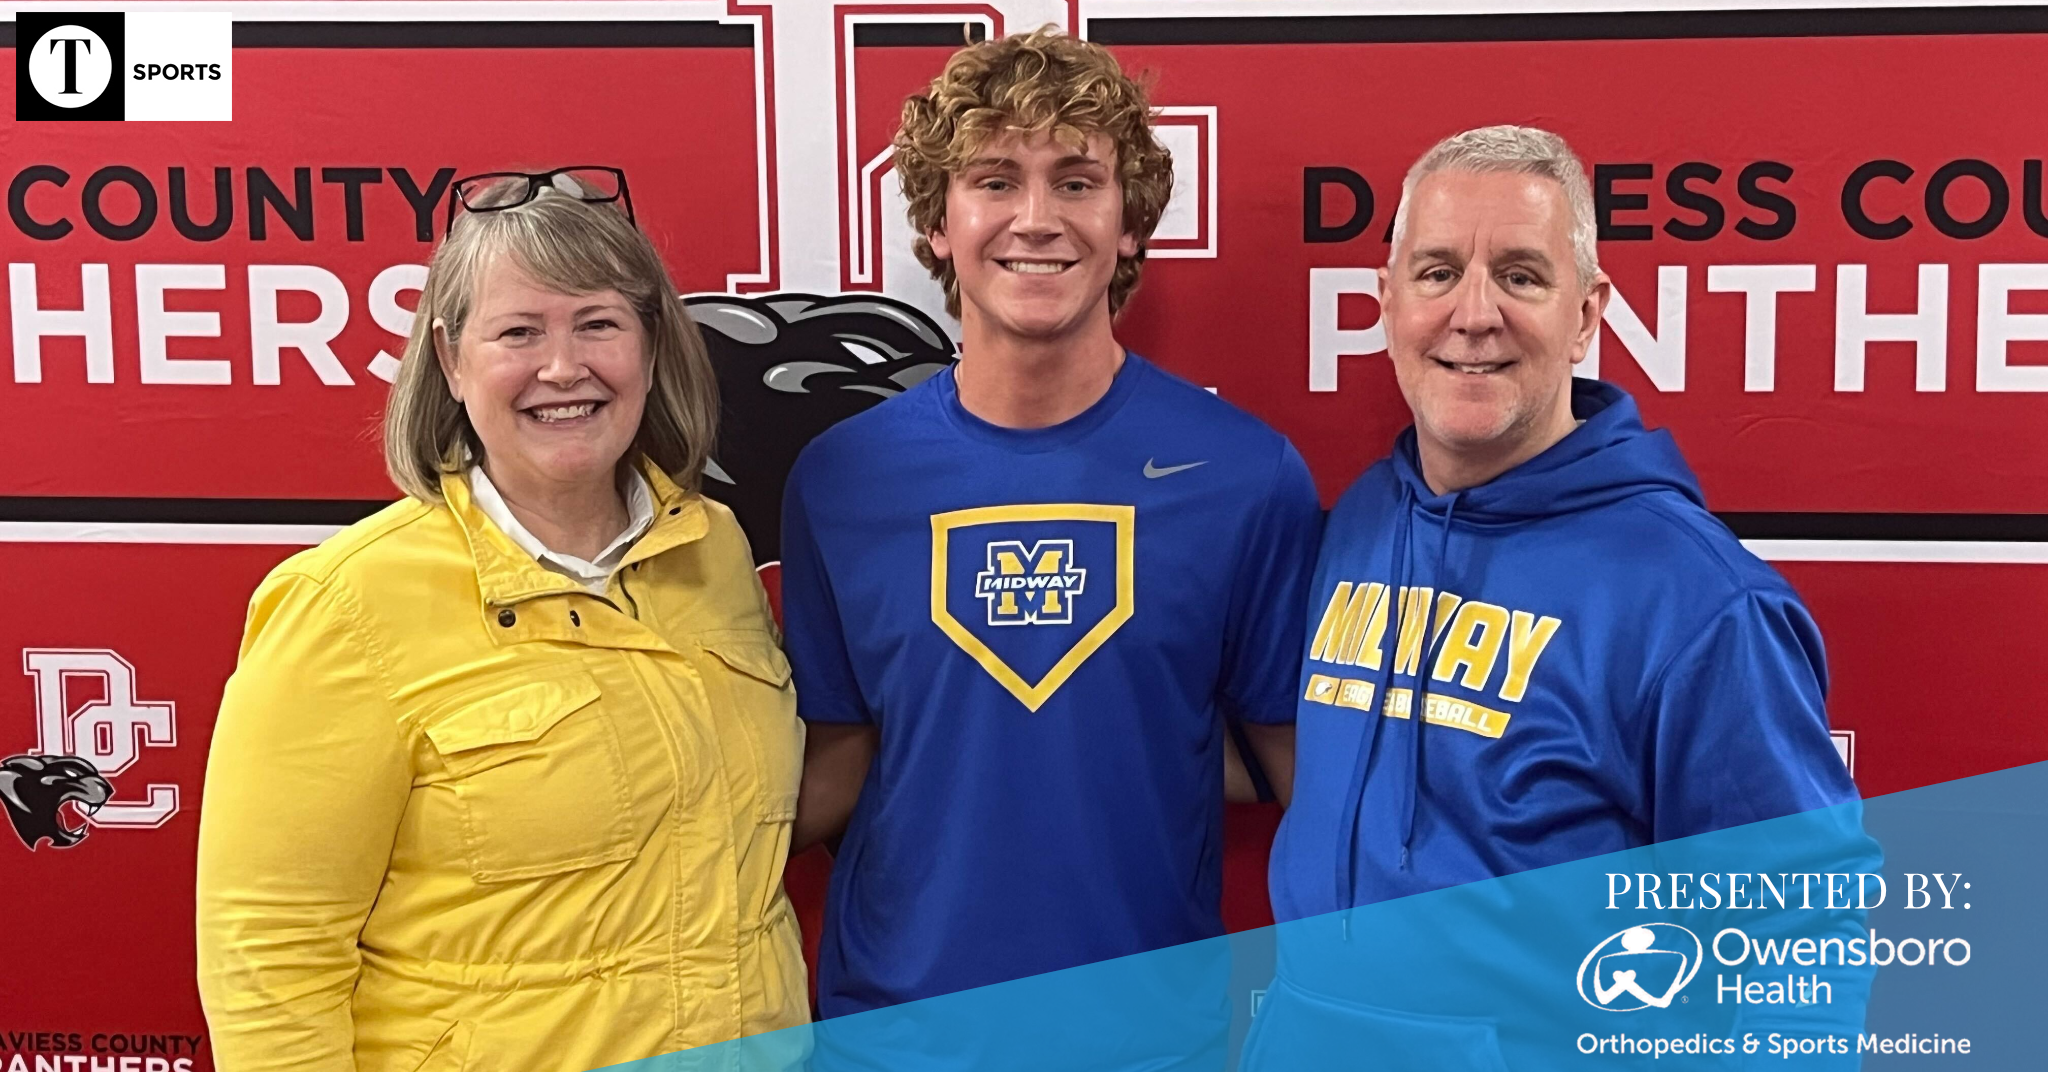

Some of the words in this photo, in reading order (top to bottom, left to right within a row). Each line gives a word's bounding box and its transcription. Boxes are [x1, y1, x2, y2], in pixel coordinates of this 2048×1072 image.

[8, 165, 457, 242] COUNTY
[1303, 162, 1797, 242] DESS
[1309, 264, 2048, 392] PNTHE
[984, 576, 1078, 590] MIDWAY
[0, 1053, 194, 1072] ANTHERS
[91, 1033, 202, 1055] COUNTY
